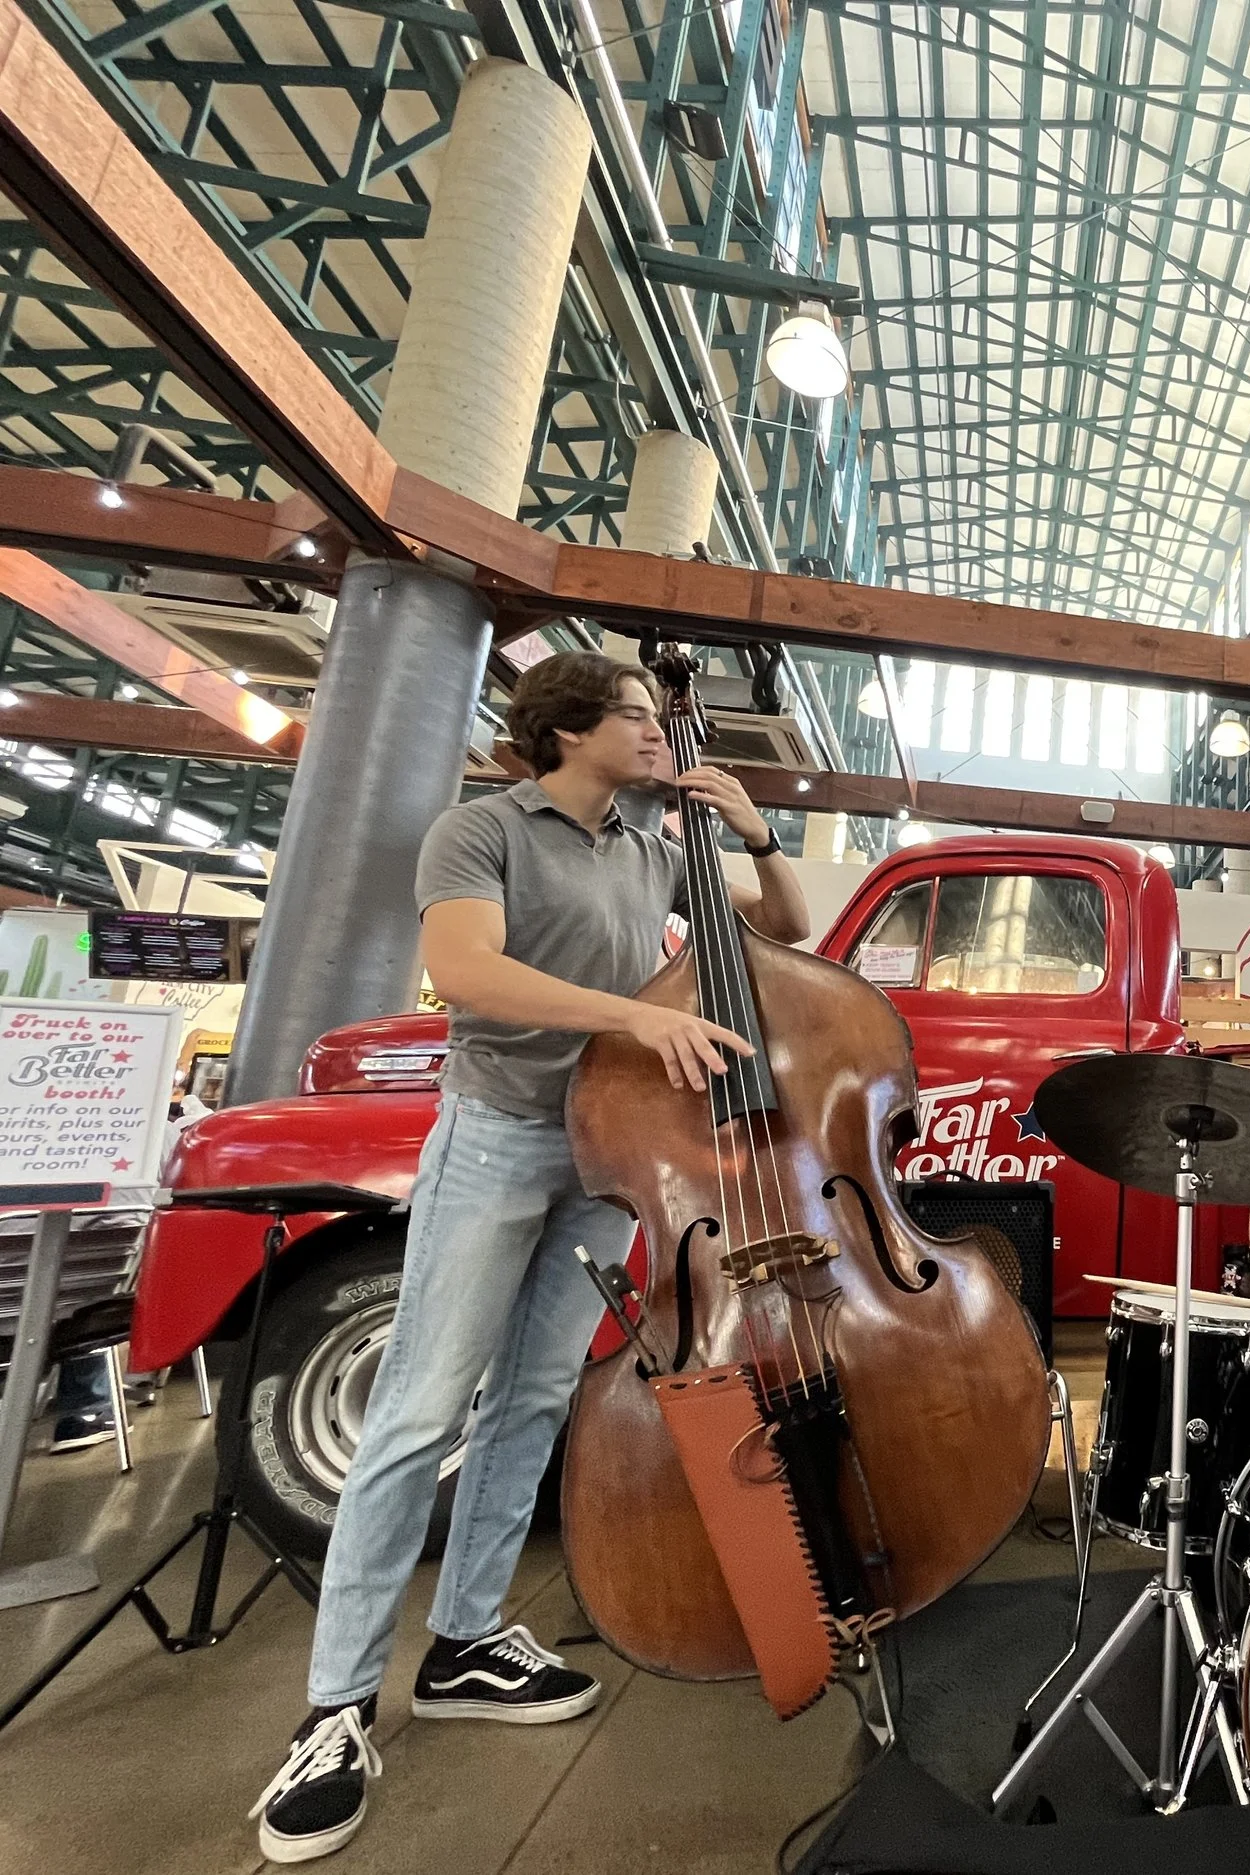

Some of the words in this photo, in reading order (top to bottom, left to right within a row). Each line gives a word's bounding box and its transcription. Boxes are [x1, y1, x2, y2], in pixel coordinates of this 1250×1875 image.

[10, 1013, 92, 1029] Truck
[99, 1021, 129, 1031] on
[2, 1030, 61, 1040] over
[69, 1031, 93, 1041] to
[102, 1033, 144, 1043] our
[48, 1042, 110, 1064] Far
[8, 1055, 136, 1087] Better
[44, 1085, 126, 1099] booth!
[0, 1106, 21, 1115] or
[26, 1103, 68, 1115] info
[75, 1106, 101, 1115] on
[108, 1106, 144, 1115] our
[910, 1076, 1011, 1149] Far
[0, 1117, 51, 1130] irits,
[58, 1117, 104, 1131] plus
[110, 1119, 146, 1128] our
[0, 1134, 48, 1144] ours,
[57, 1131, 131, 1142] events,
[0, 1144, 39, 1156] and
[45, 1144, 120, 1158] tasting
[23, 1158, 89, 1170] room!
[894, 1139, 1058, 1182] etter
